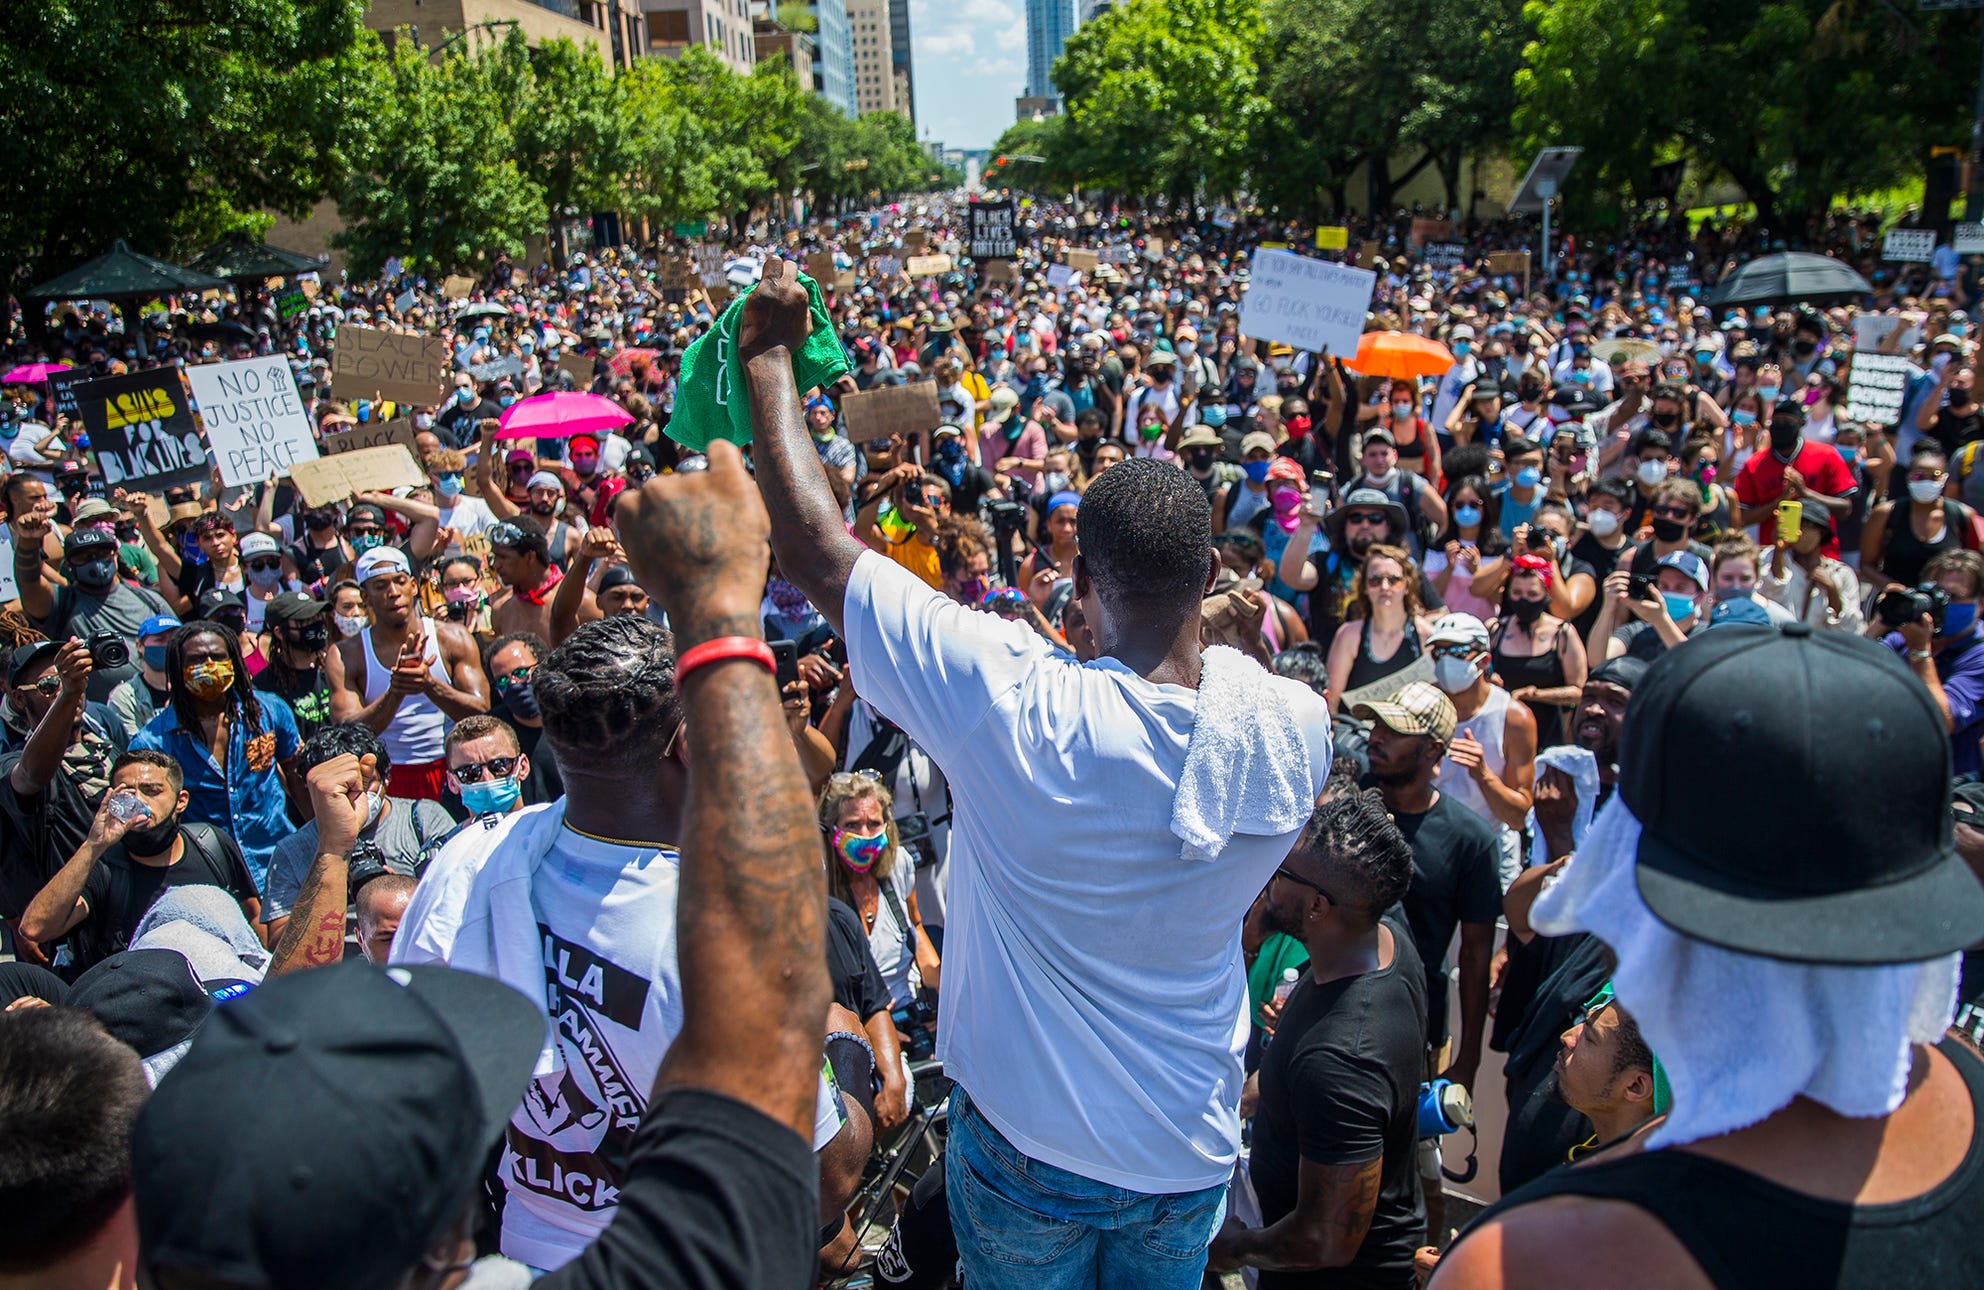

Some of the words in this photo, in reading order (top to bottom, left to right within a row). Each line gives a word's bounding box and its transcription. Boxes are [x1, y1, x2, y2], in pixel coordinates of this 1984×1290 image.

[338, 326, 438, 359] BLACK
[217, 368, 260, 398] NO
[338, 354, 441, 384] POWER
[204, 392, 300, 428] JUSTICE
[124, 419, 169, 446] FOR
[240, 421, 275, 445] NO
[98, 442, 160, 484] BLACK
[154, 432, 207, 474] LIVES
[228, 439, 300, 480] PEACE
[76, 533, 100, 544] LSU
[504, 1150, 620, 1207] KLICK
